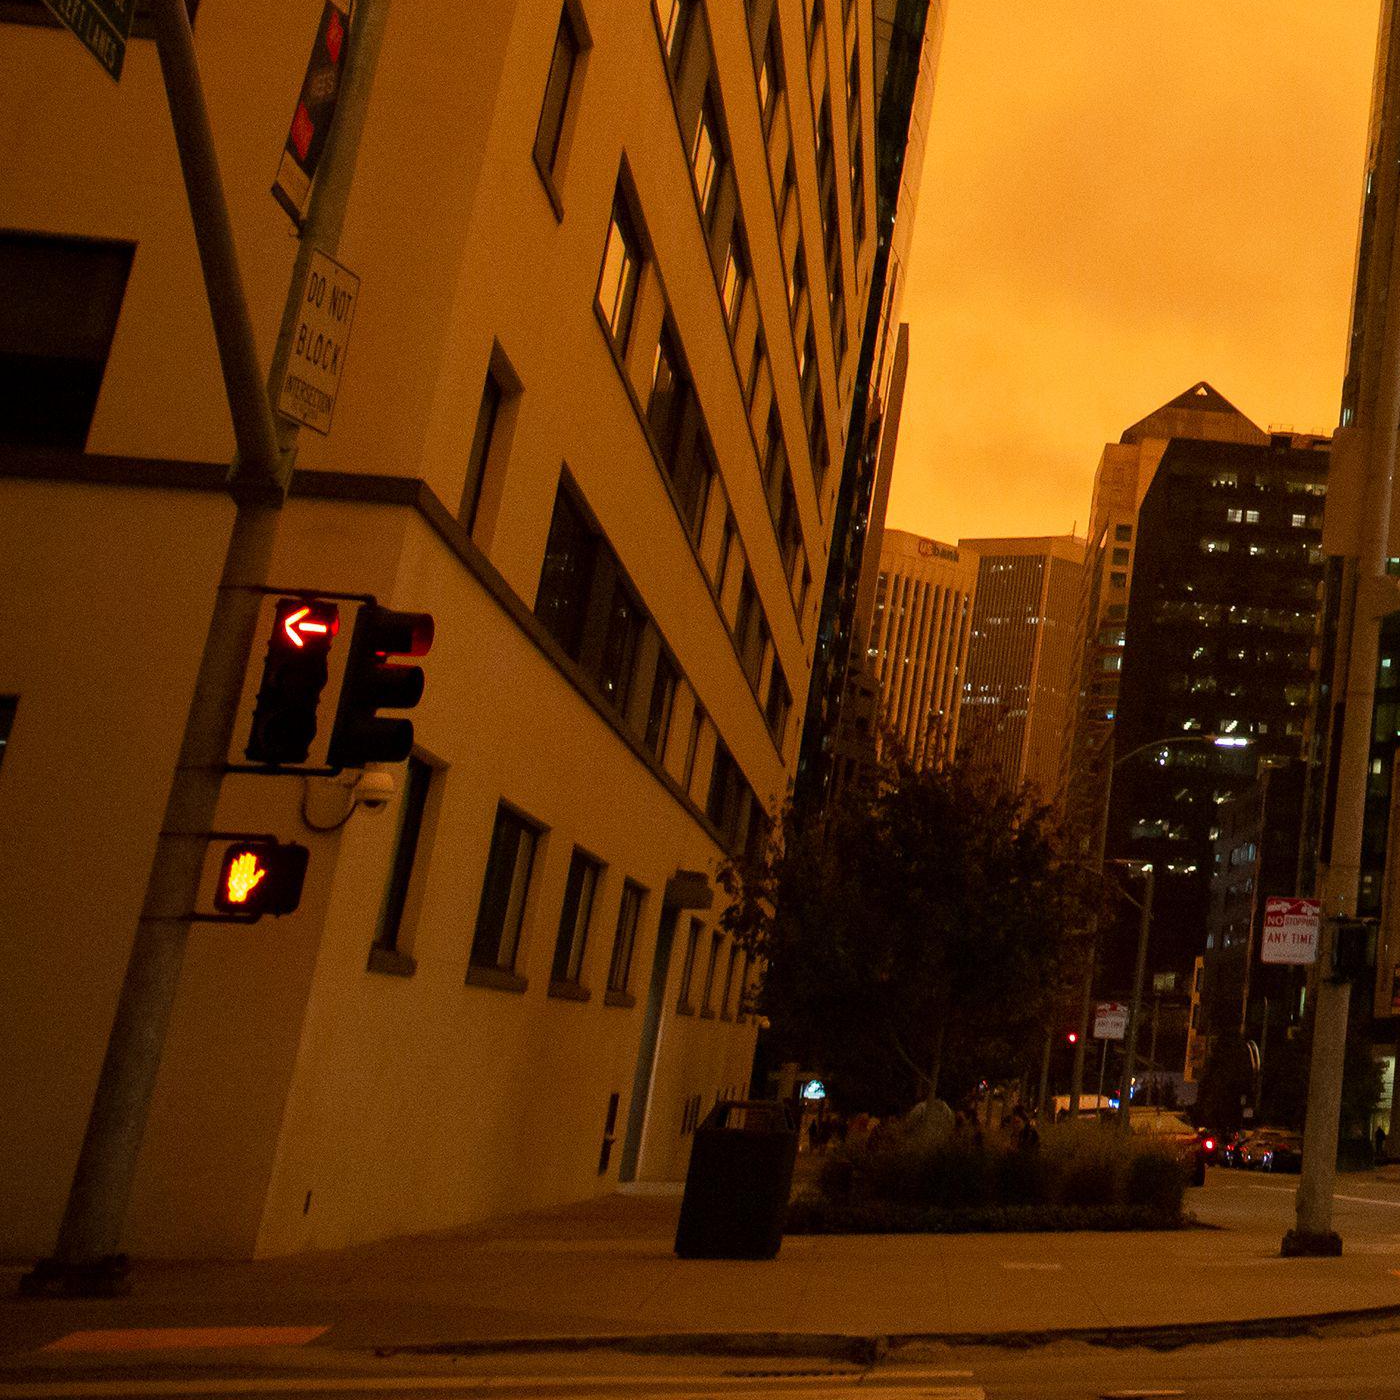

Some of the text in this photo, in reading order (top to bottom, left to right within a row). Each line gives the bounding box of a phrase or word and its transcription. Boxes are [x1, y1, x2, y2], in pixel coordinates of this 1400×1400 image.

[86, 15, 117, 70] LANES
[307, 271, 352, 322] DO NOT
[296, 322, 341, 376] BLOCK
[1267, 915, 1284, 926] NO
[1267, 933, 1313, 945] ANY TIME
